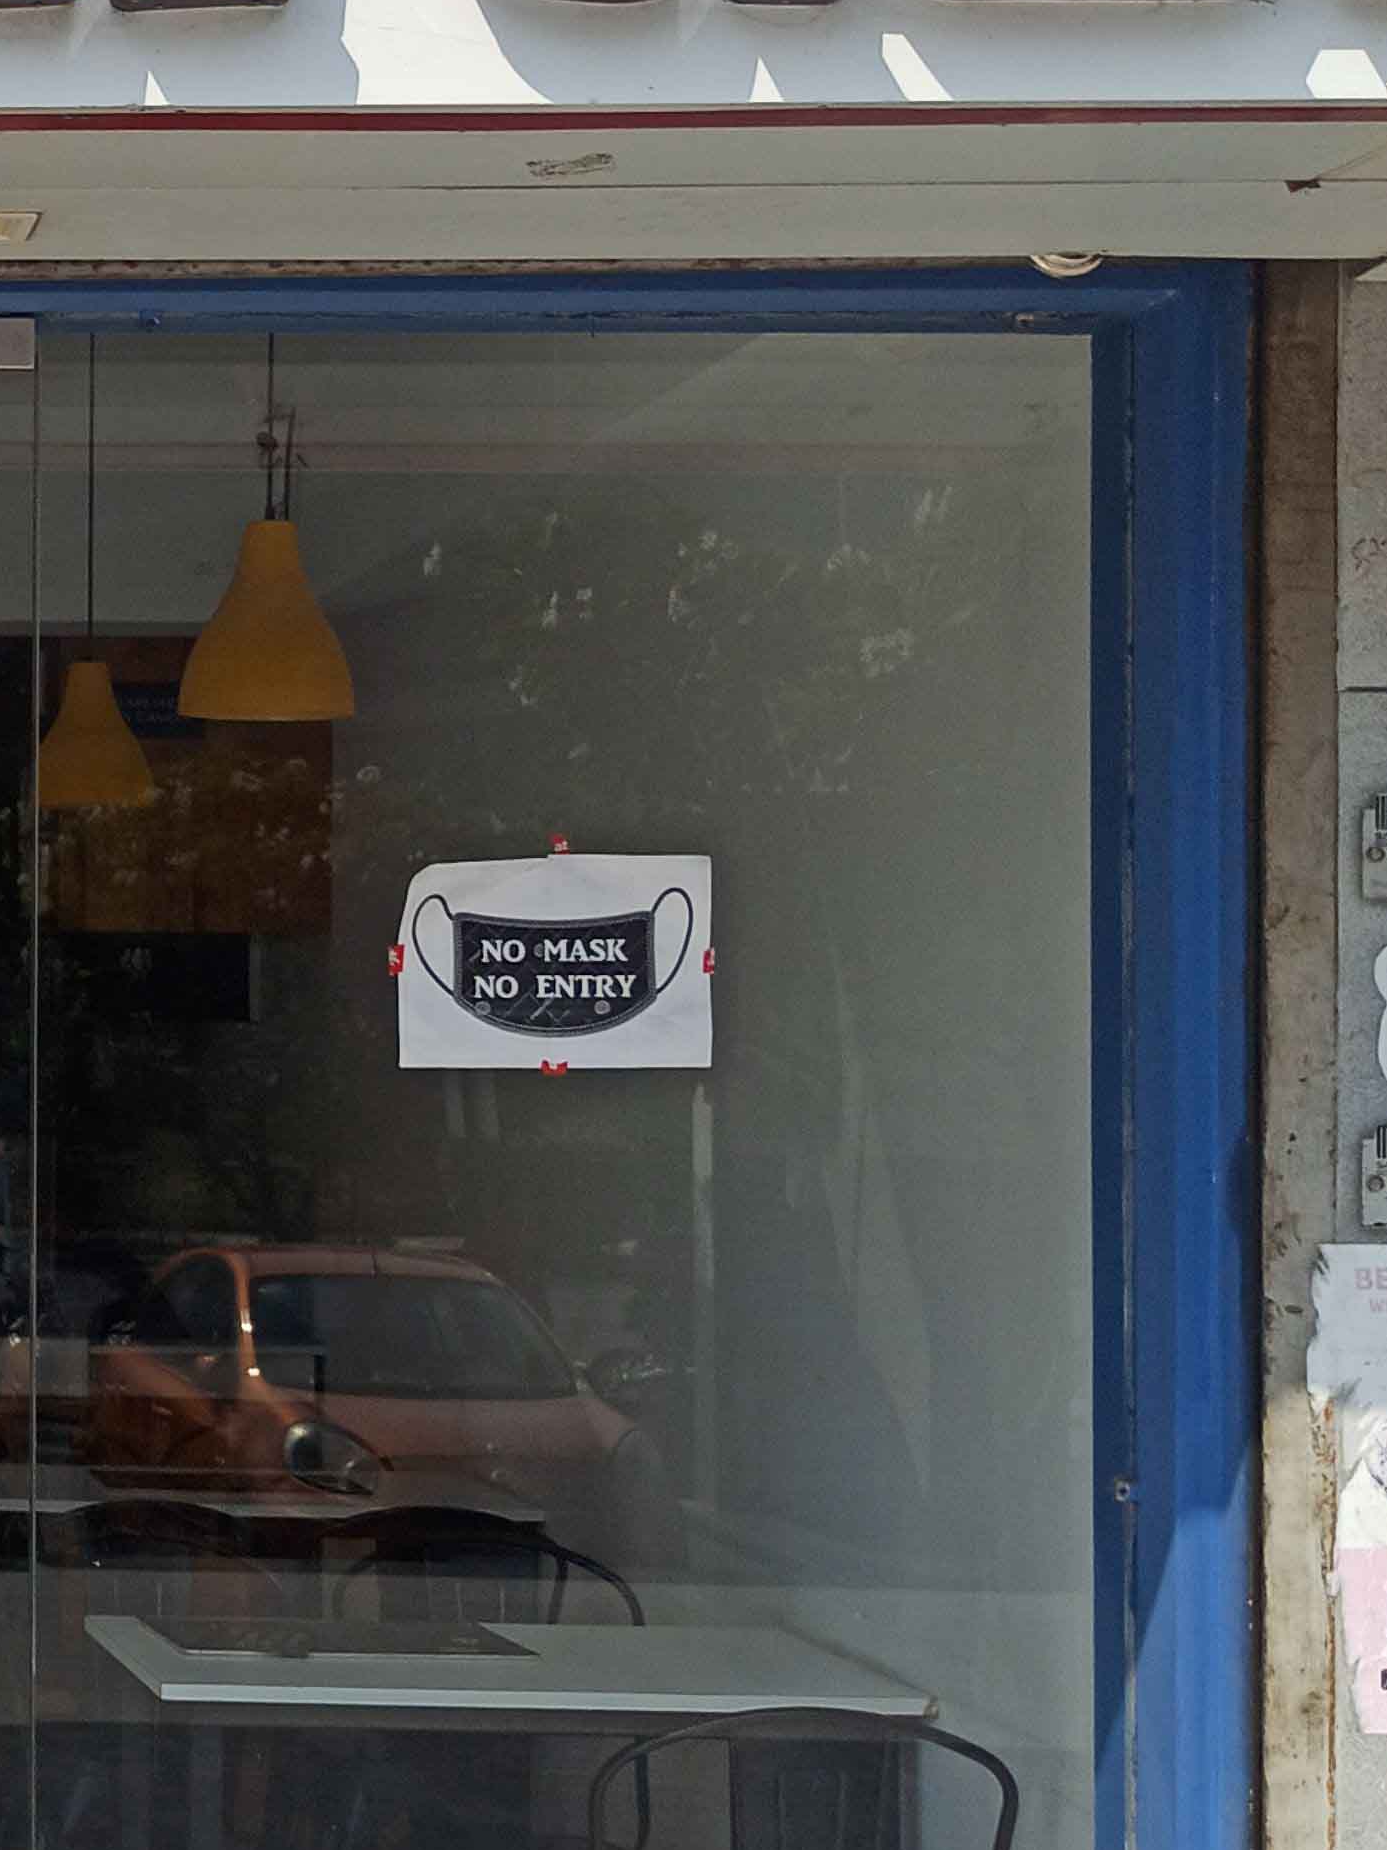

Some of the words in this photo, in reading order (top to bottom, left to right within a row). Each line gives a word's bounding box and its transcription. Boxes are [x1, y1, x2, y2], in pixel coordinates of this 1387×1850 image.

[480, 939, 526, 963] NO
[542, 938, 628, 963] MASK
[474, 975, 519, 999] NO
[535, 974, 637, 999] ENTRY
